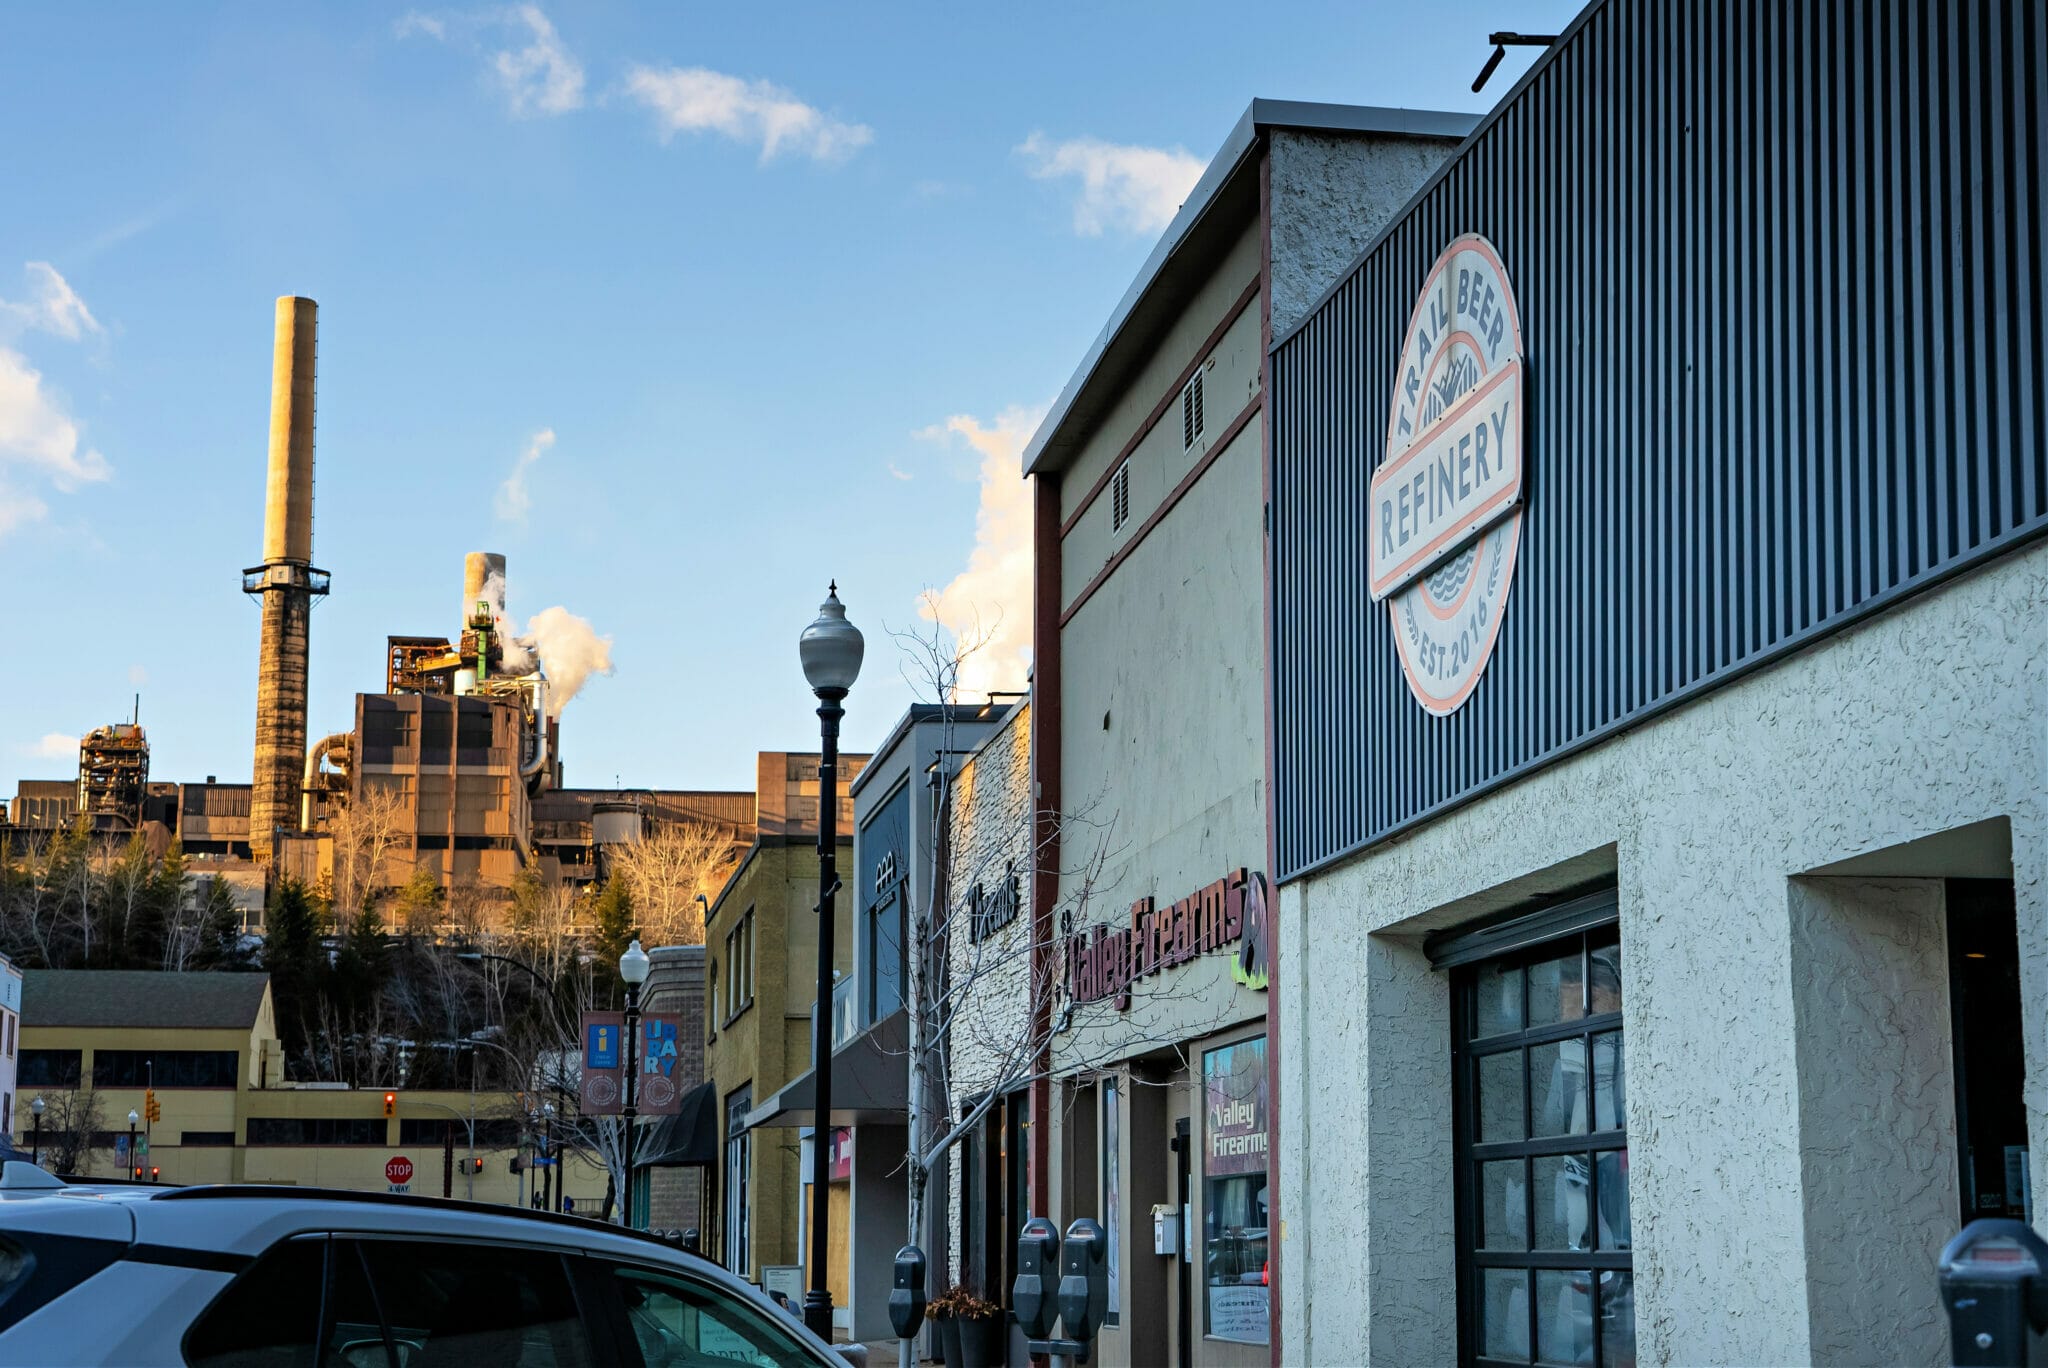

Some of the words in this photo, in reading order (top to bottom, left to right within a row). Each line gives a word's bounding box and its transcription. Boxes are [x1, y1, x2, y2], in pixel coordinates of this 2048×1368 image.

[1397, 287, 1449, 437] TRAIL
[1456, 268, 1504, 363] BEER
[1381, 401, 1509, 560] REFINERY
[1068, 923, 1130, 1011] Valley
[1129, 868, 1247, 982] Firearms
[387, 1164, 411, 1176] STOP
[1214, 1100, 1254, 1130] Valley
